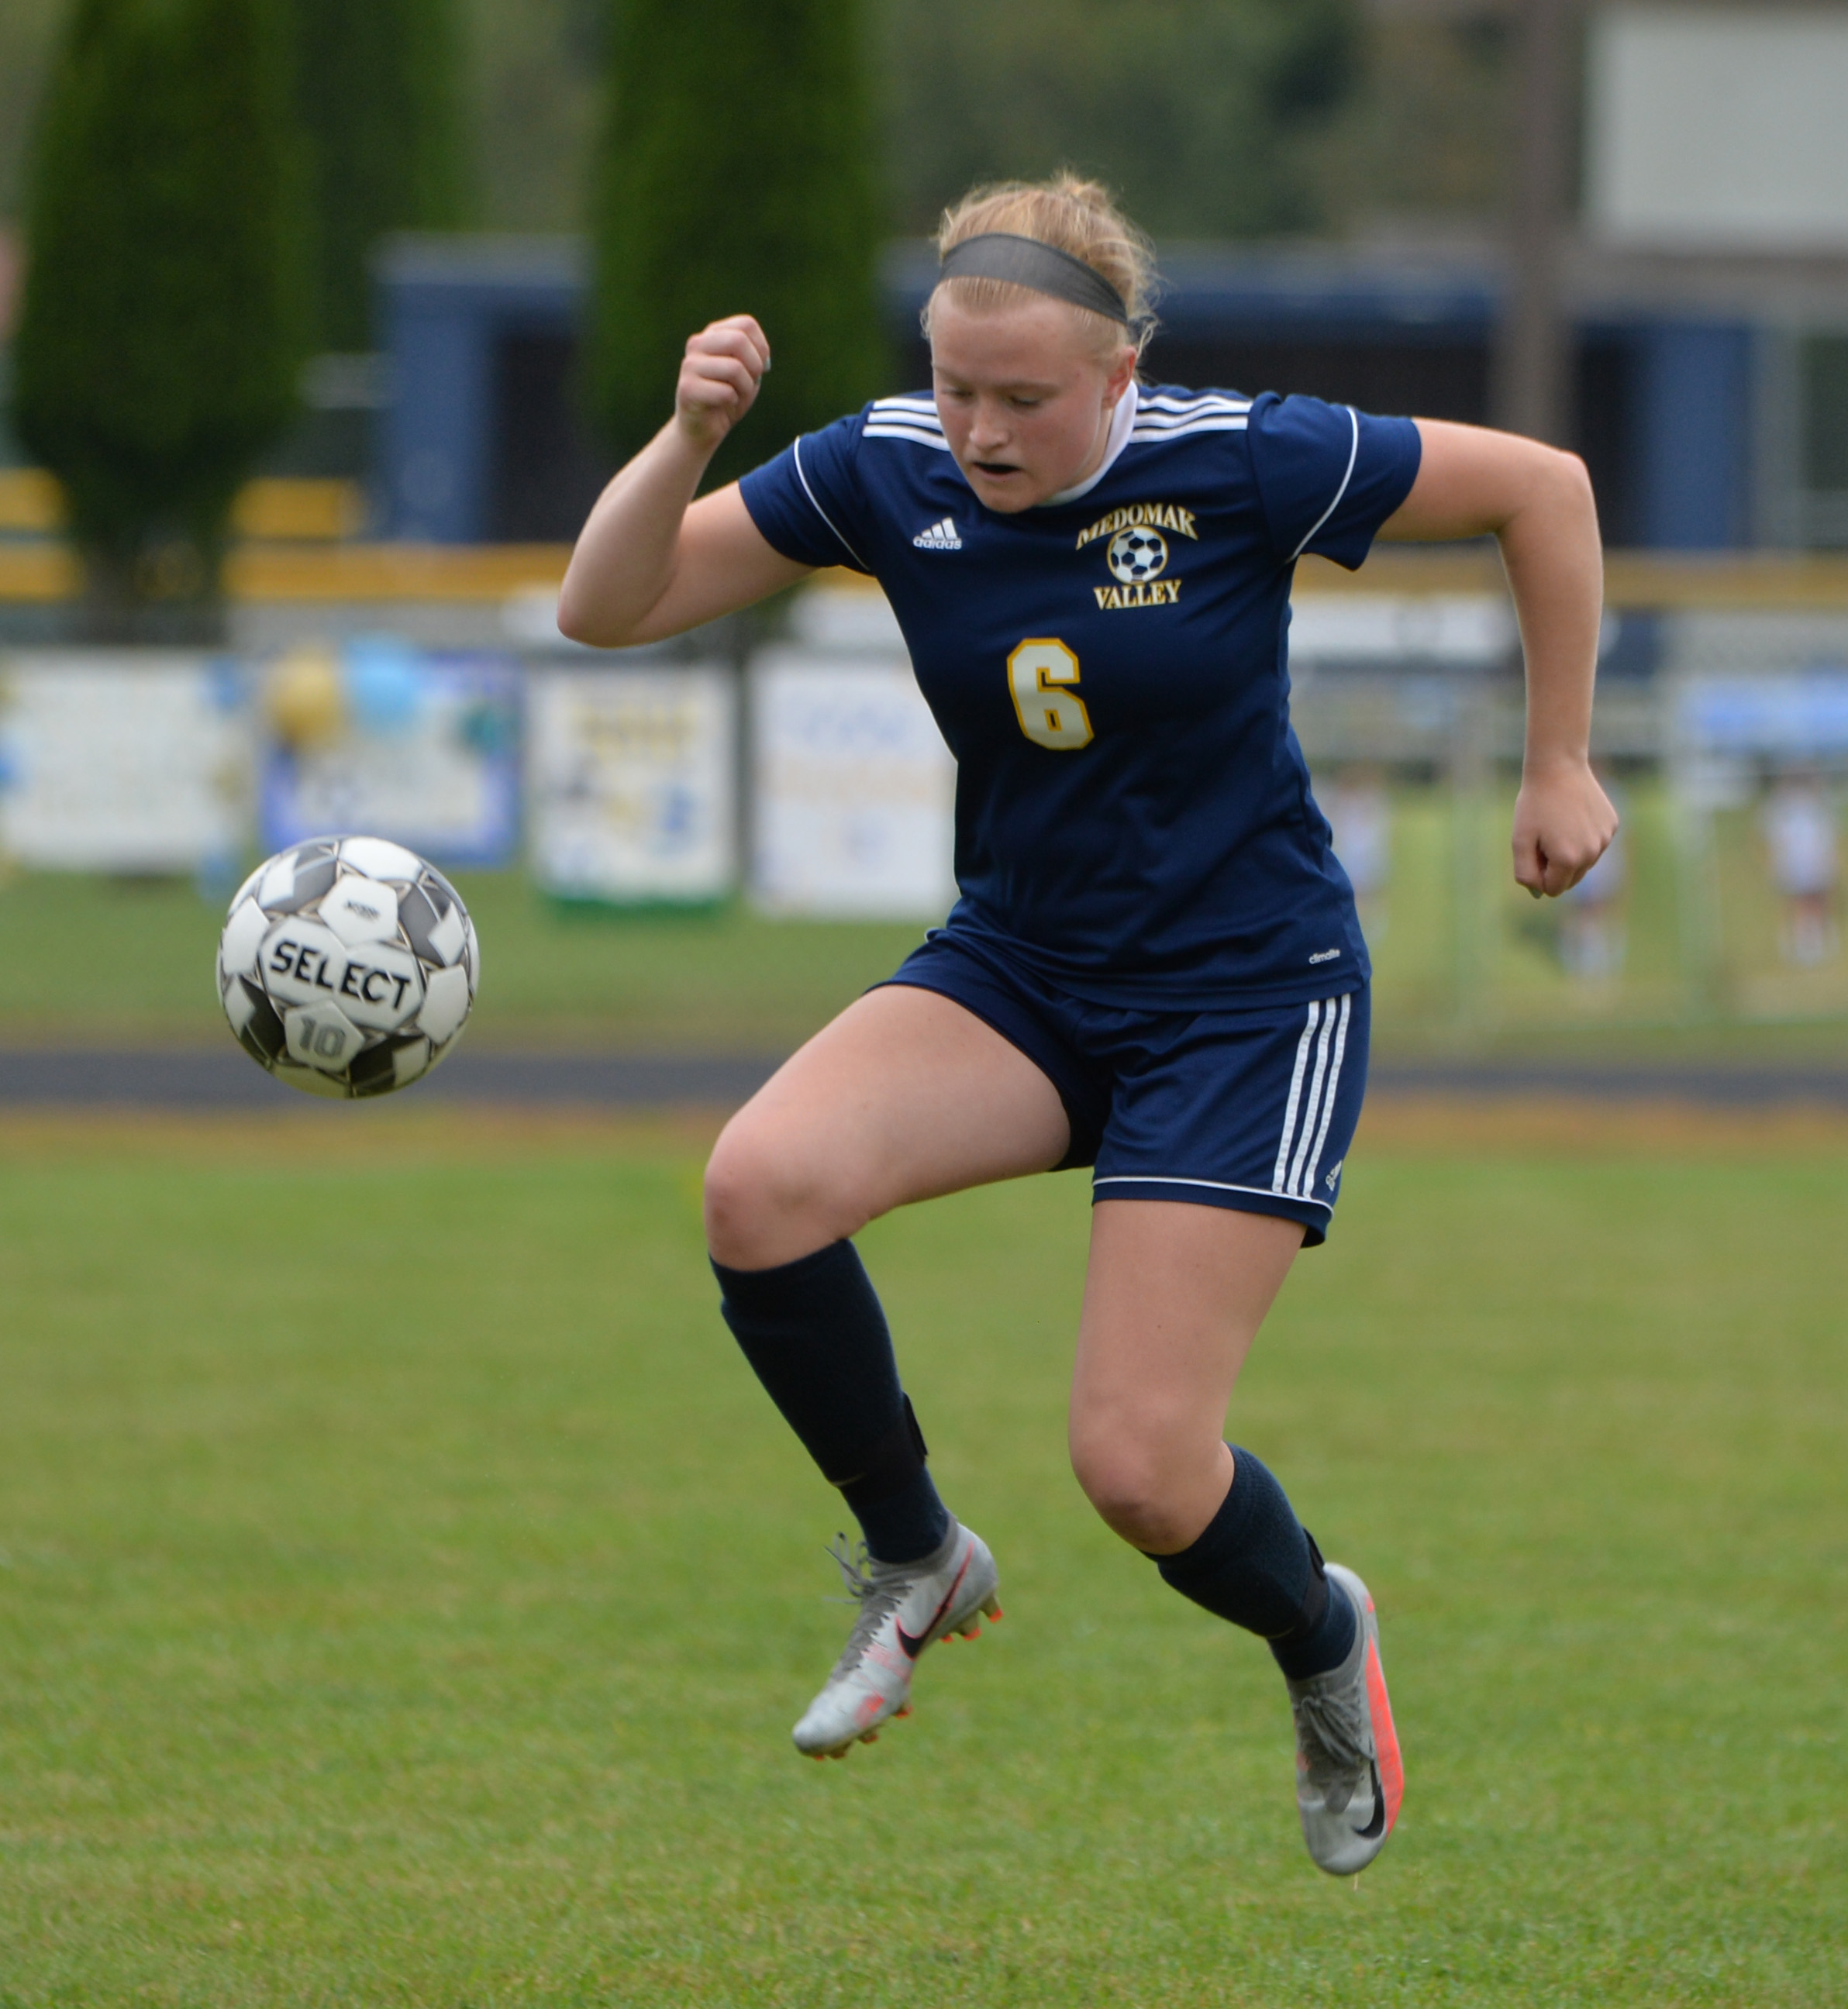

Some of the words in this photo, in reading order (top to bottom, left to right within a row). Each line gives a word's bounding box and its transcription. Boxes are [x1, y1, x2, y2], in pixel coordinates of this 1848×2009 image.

[913, 536, 962, 550] adidas
[1075, 503, 1198, 550] MEDOMAK
[1093, 579, 1181, 610] VALLEY
[1007, 637, 1095, 750] 6
[271, 941, 410, 1009] SELECT
[299, 1016, 346, 1059] 10
